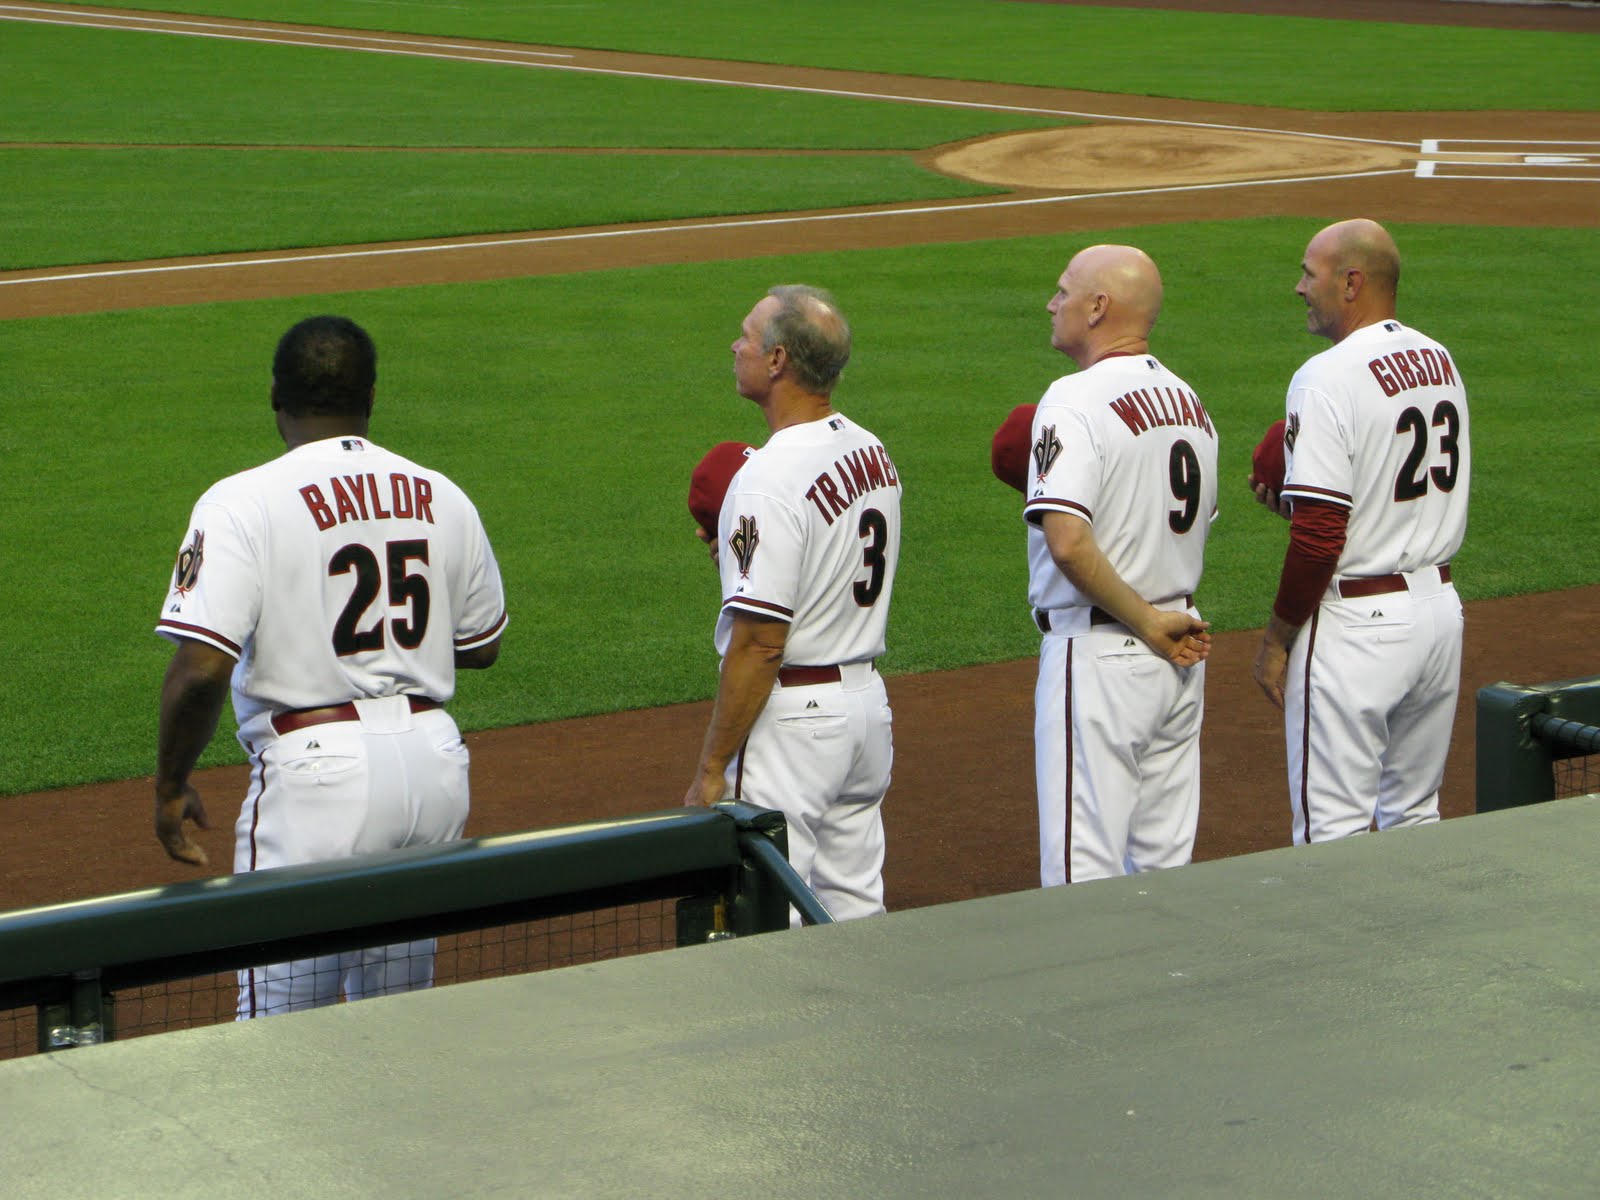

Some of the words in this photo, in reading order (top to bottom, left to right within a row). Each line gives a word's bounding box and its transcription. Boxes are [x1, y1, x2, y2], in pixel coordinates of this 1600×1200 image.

[1368, 348, 1456, 398] GIBSON
[805, 445, 897, 526] TRAMME
[1169, 439, 1201, 534] 9
[1394, 400, 1460, 502] 23
[298, 473, 435, 532] BAYLOR
[328, 538, 431, 658] 25
[853, 508, 888, 608] 3
